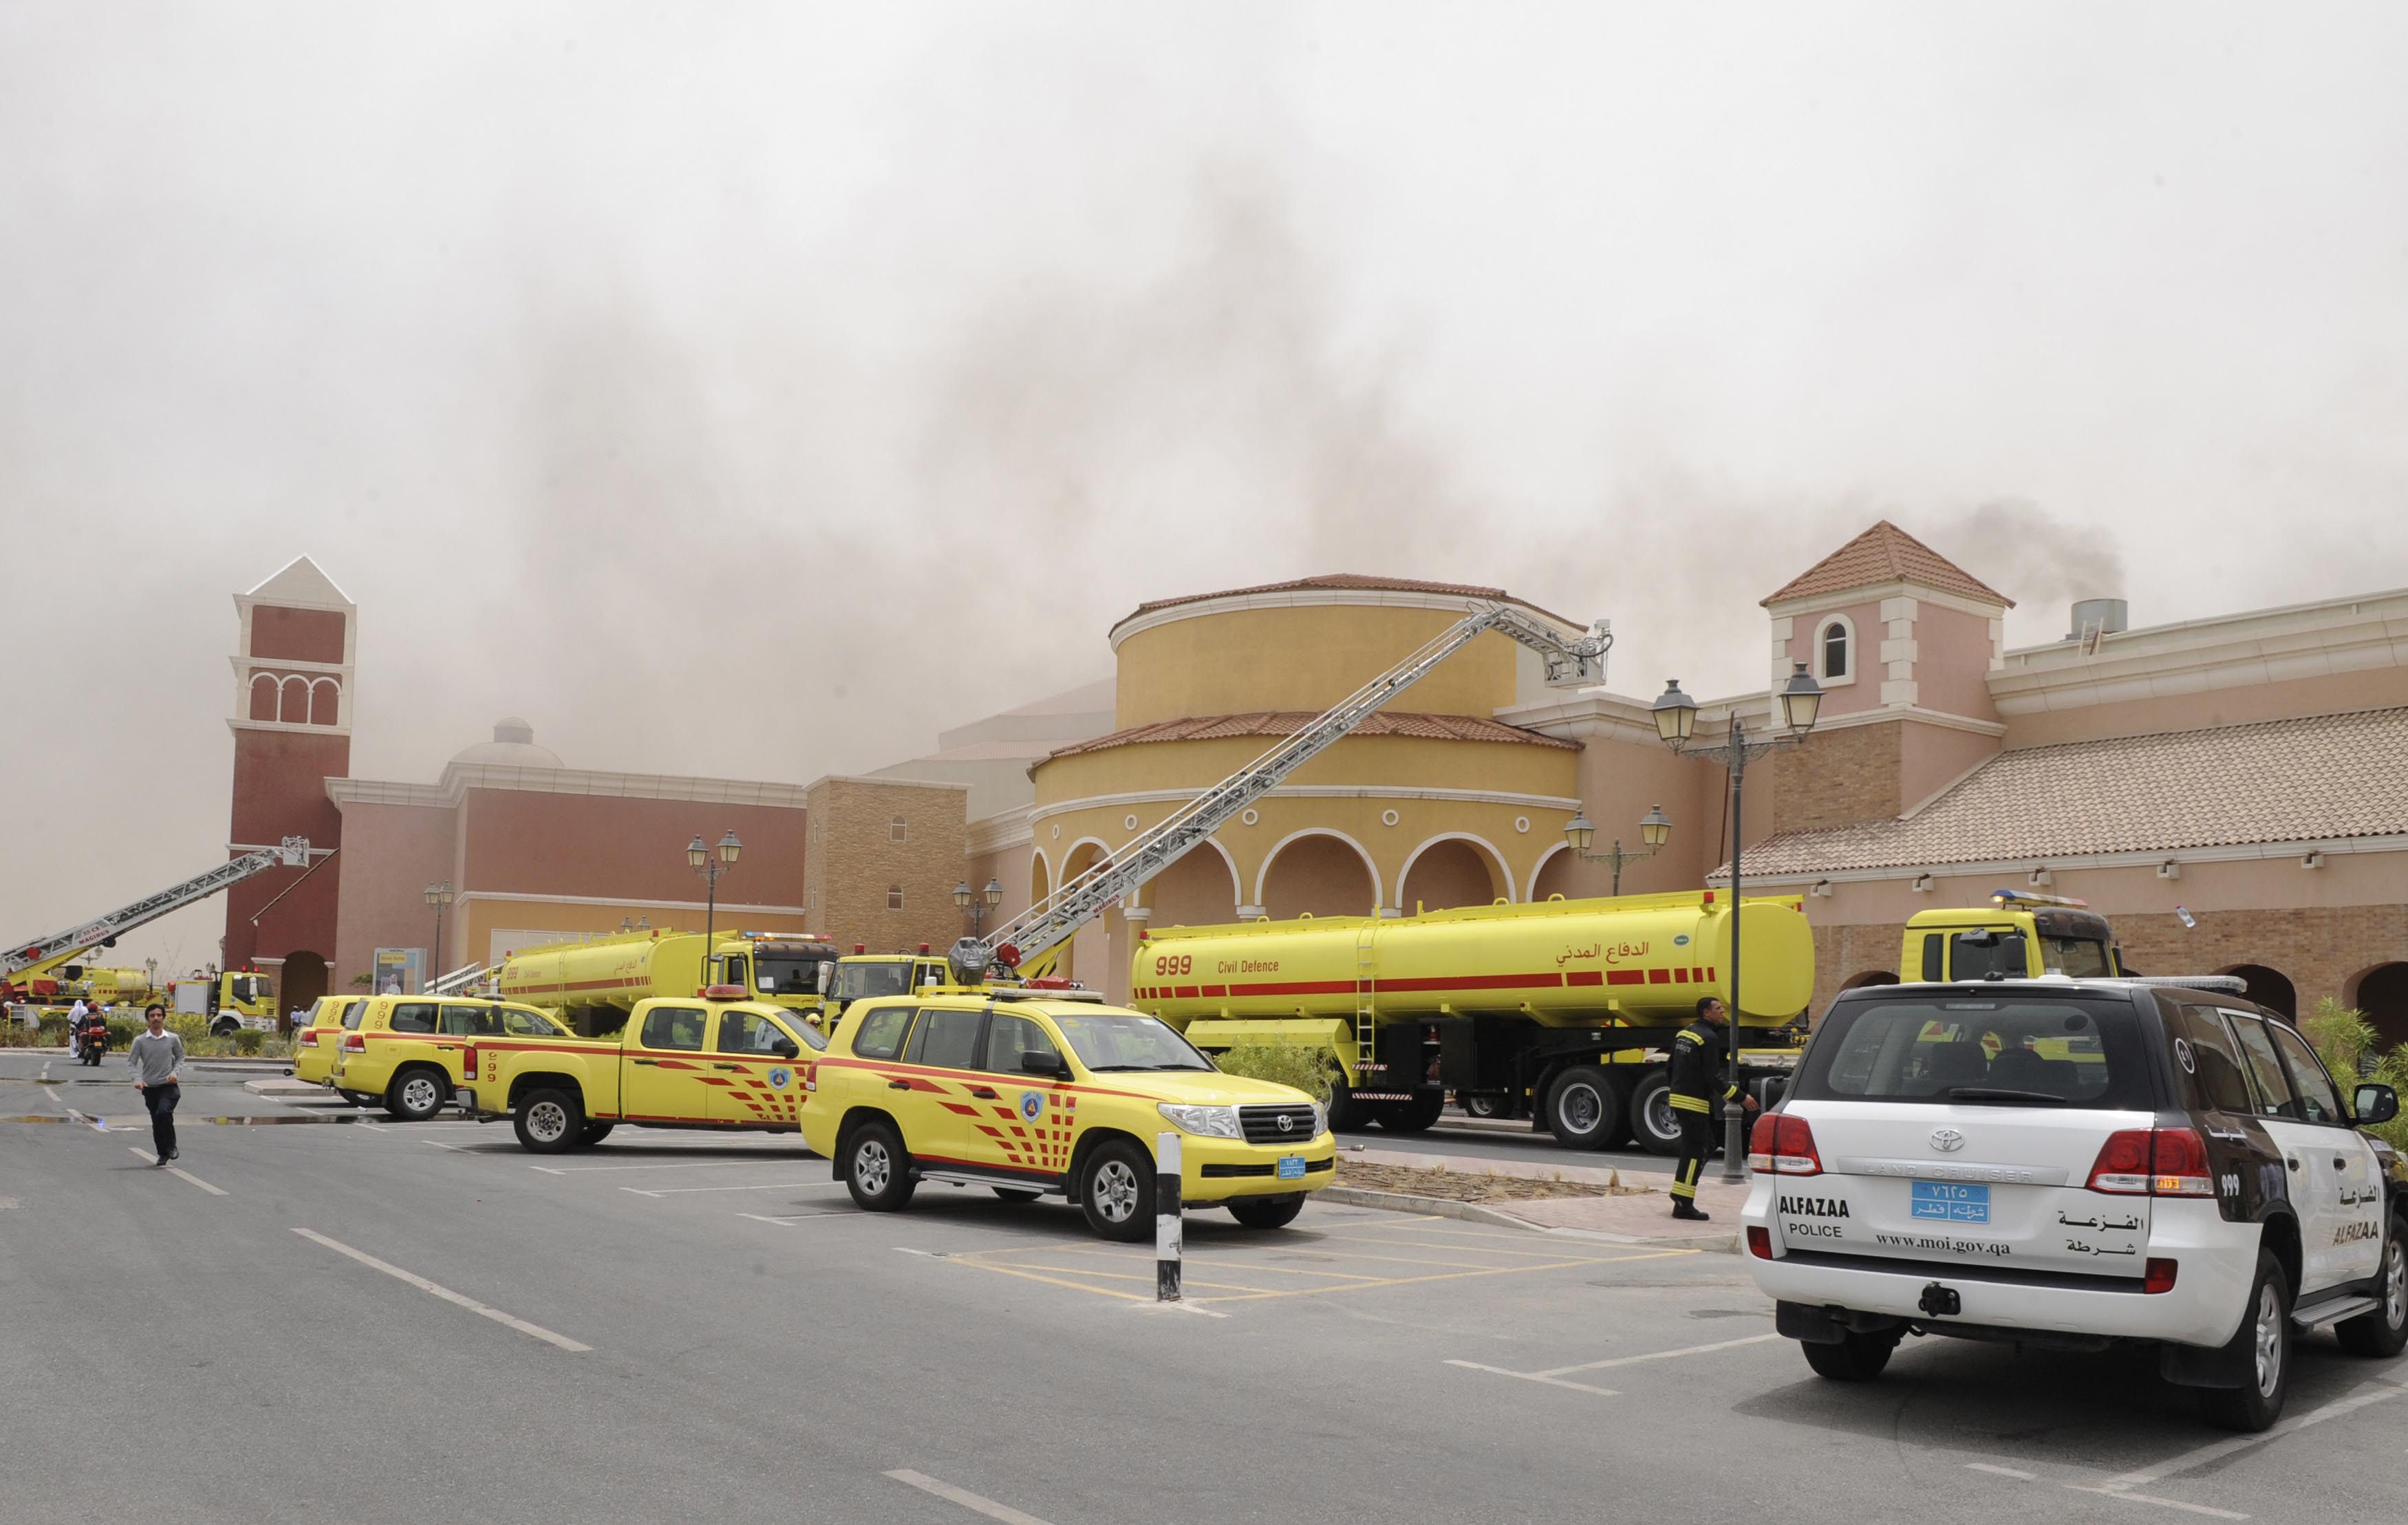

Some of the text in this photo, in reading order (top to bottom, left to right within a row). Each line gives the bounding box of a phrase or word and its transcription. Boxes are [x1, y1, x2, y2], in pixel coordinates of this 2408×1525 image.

[1093, 894, 1120, 913] MAGIRUS
[78, 929, 110, 944] MAGIRUS
[1156, 955, 1279, 976] 999 Civil Defence
[1556, 942, 1649, 967] الدفاع المدني
[327, 1001, 339, 1024] 999
[374, 1002, 389, 1029] 999
[1864, 1162, 2033, 1183] LAND CRUISER
[2222, 1174, 2239, 1197] 999
[1779, 1196, 1851, 1218] ALFAZAA
[1916, 1203, 1946, 1215] قطر
[1789, 1222, 1843, 1238] POLICE
[2058, 1210, 2144, 1233] الفزعة
[1876, 1233, 2011, 1255] www.moi.gov.qa
[2332, 1220, 2379, 1246] ALFAZAA
[2066, 1239, 2136, 1256] شرطة
